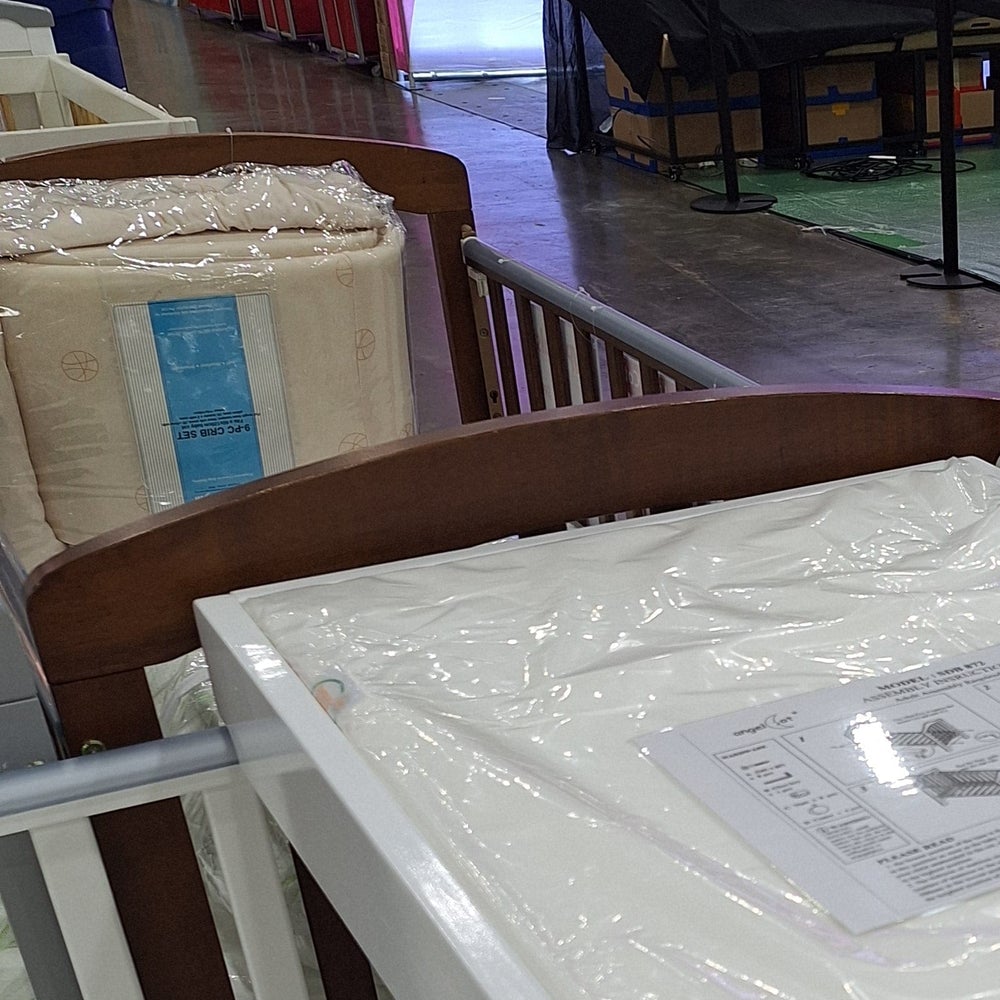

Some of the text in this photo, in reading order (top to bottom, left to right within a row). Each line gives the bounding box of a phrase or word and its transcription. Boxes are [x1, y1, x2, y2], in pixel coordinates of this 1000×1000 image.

[177, 423, 251, 440] 9-PC CRIB SET
[876, 676, 930, 690] MODEL
[863, 681, 930, 704] ASSEMBLY
[876, 847, 921, 866] PLEASE
